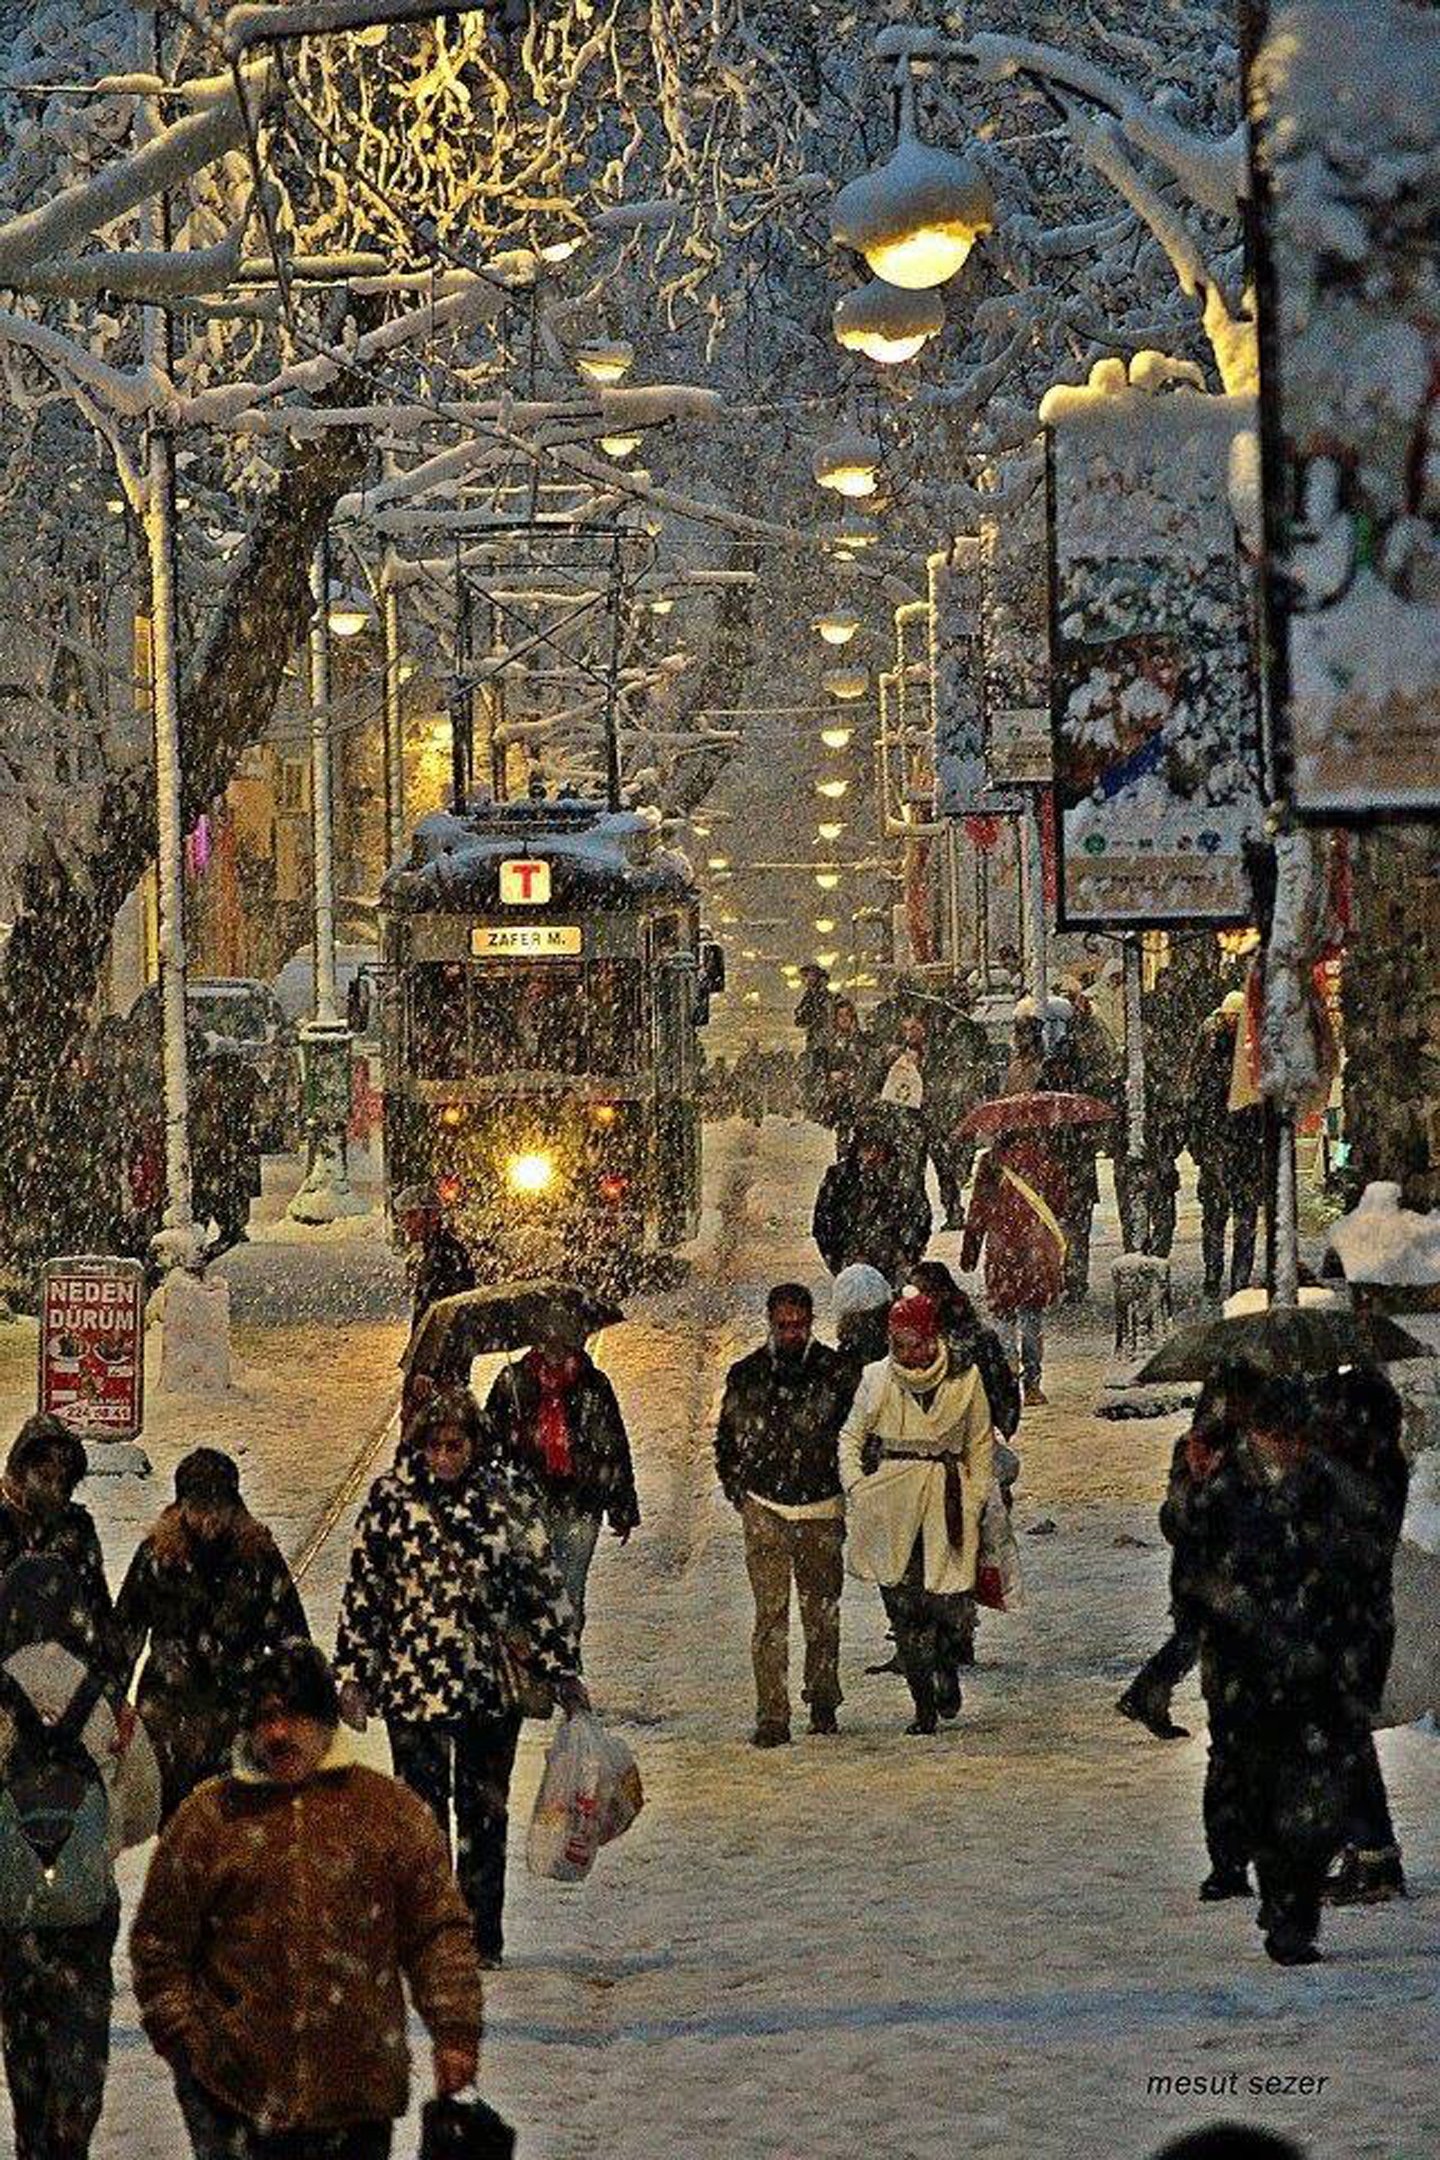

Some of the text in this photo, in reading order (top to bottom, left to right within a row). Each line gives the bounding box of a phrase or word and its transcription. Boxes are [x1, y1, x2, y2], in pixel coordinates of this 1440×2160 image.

[512, 864, 541, 899] T
[487, 932, 566, 947] ZAFER M.
[51, 1281, 134, 1303] NEDEN
[50, 1304, 134, 1330] DÜRÜM
